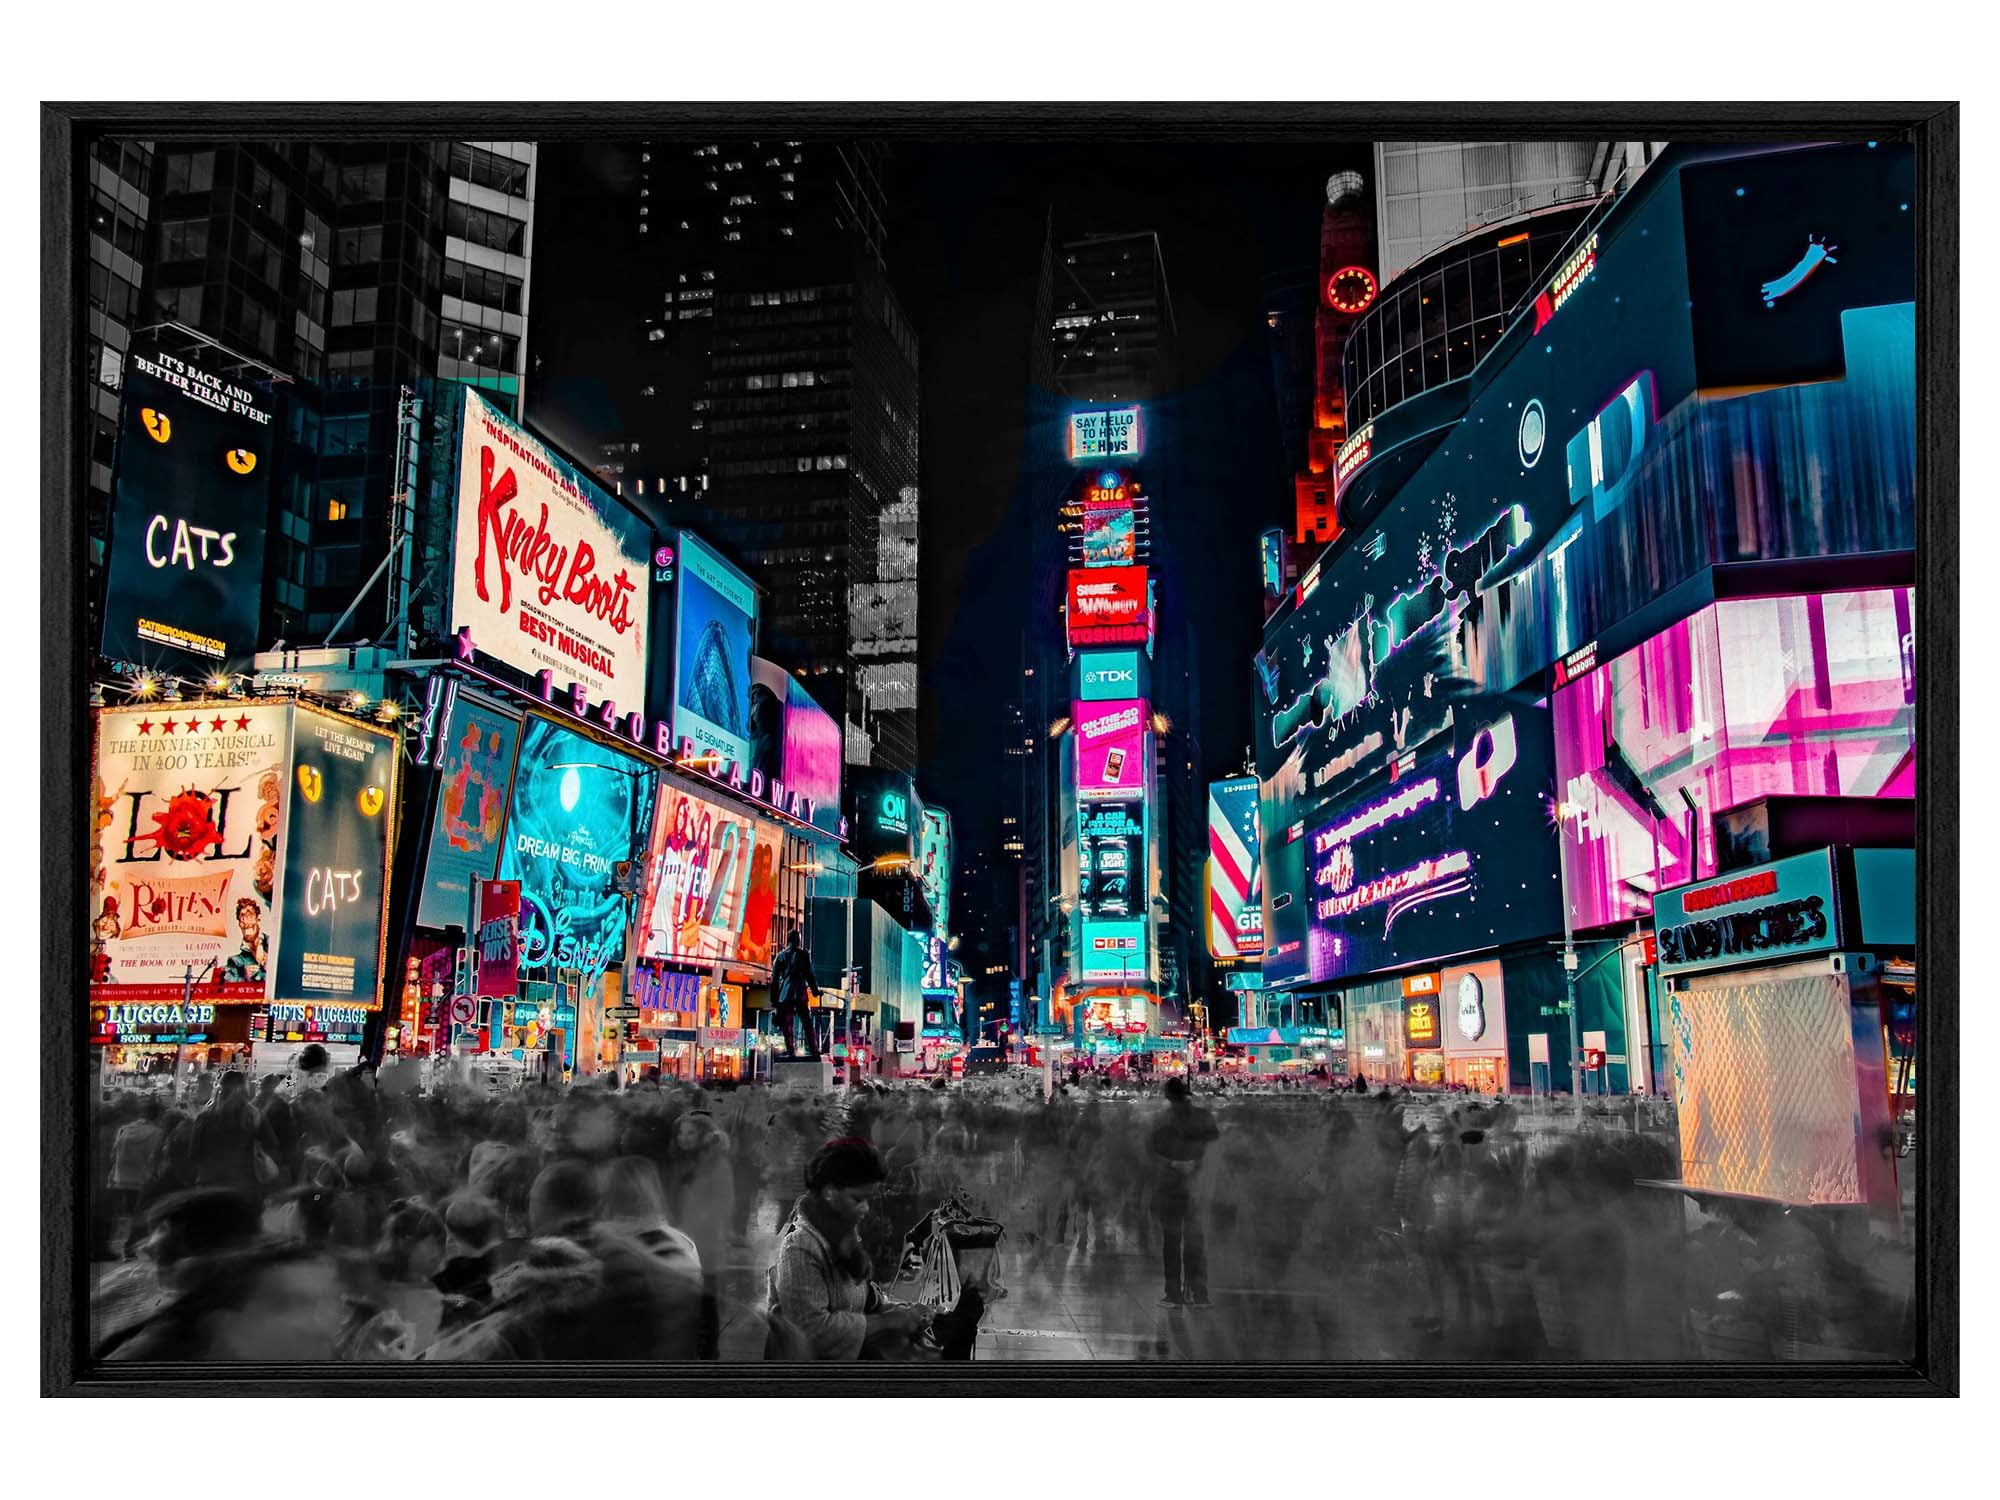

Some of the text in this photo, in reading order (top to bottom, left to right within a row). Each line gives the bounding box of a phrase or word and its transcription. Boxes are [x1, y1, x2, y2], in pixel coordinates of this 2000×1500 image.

[1552, 233, 1598, 294] MARRIOTT
[1554, 259, 1594, 311] MARQUIS
[158, 352, 185, 374] IT'S
[187, 365, 222, 390] BACK
[224, 384, 253, 403] AND
[192, 382, 230, 408] THAN
[1076, 415, 1133, 428] SAY HELLO
[1082, 426, 1128, 439] TO HAYS
[1091, 488, 1124, 501] 2016
[145, 514, 237, 570] CATS
[474, 444, 637, 635] Kinky Boots
[655, 570, 673, 582] LG
[520, 610, 556, 647] BEST
[558, 631, 614, 679] MUSICAL
[1096, 669, 1133, 682] TDK
[1081, 707, 1139, 731] ON-THE-GO
[1085, 716, 1139, 739] ORDERING
[110, 734, 276, 754] THE FUNNIEST MUSICAL
[315, 726, 376, 754] LET THE MEMORY
[324, 741, 365, 762] LIVE AGAIN
[540, 669, 647, 743] 1540
[656, 721, 816, 823] BROADWAY
[695, 726, 736, 757] LG SIGNATURE
[132, 756, 150, 771] IN
[155, 755, 188, 770] 400
[883, 795, 905, 820] ON
[517, 834, 560, 860] DREAM
[561, 847, 581, 868] BIG,
[1102, 852, 1124, 860] BUD
[702, 821, 756, 932] 21
[306, 867, 363, 916] CATS
[484, 938, 511, 962] BOYS
[633, 967, 700, 1012] FOREVER
[107, 1005, 215, 1024] LUGGAGE
[269, 1004, 367, 1024] GIFTS LUGGAGE
[116, 1024, 136, 1034] NY
[121, 1035, 151, 1043] SONY
[327, 1034, 347, 1042] SONY
